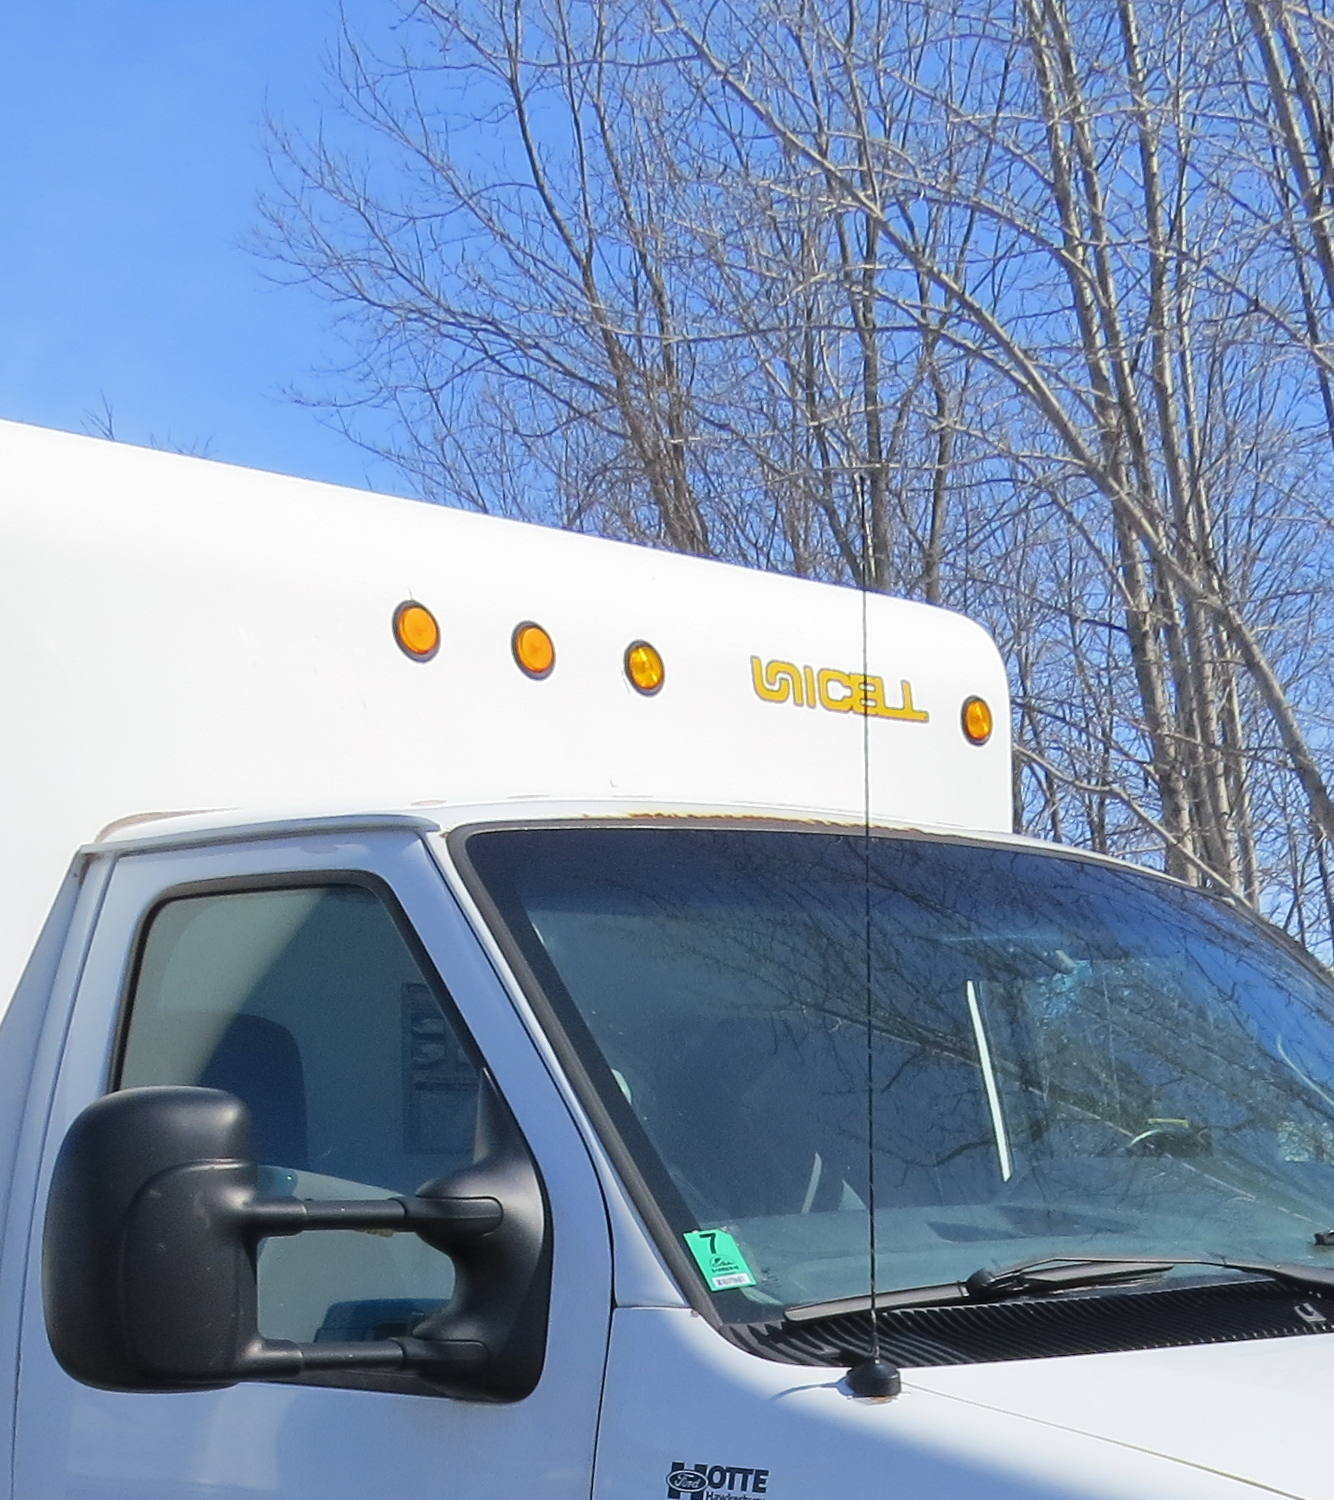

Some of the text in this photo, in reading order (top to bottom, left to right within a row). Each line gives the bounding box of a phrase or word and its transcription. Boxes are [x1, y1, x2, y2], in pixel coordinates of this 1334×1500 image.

[750, 655, 929, 723] UNICELL
[699, 1232, 717, 1255] 7
[673, 1472, 702, 1489] Ford
